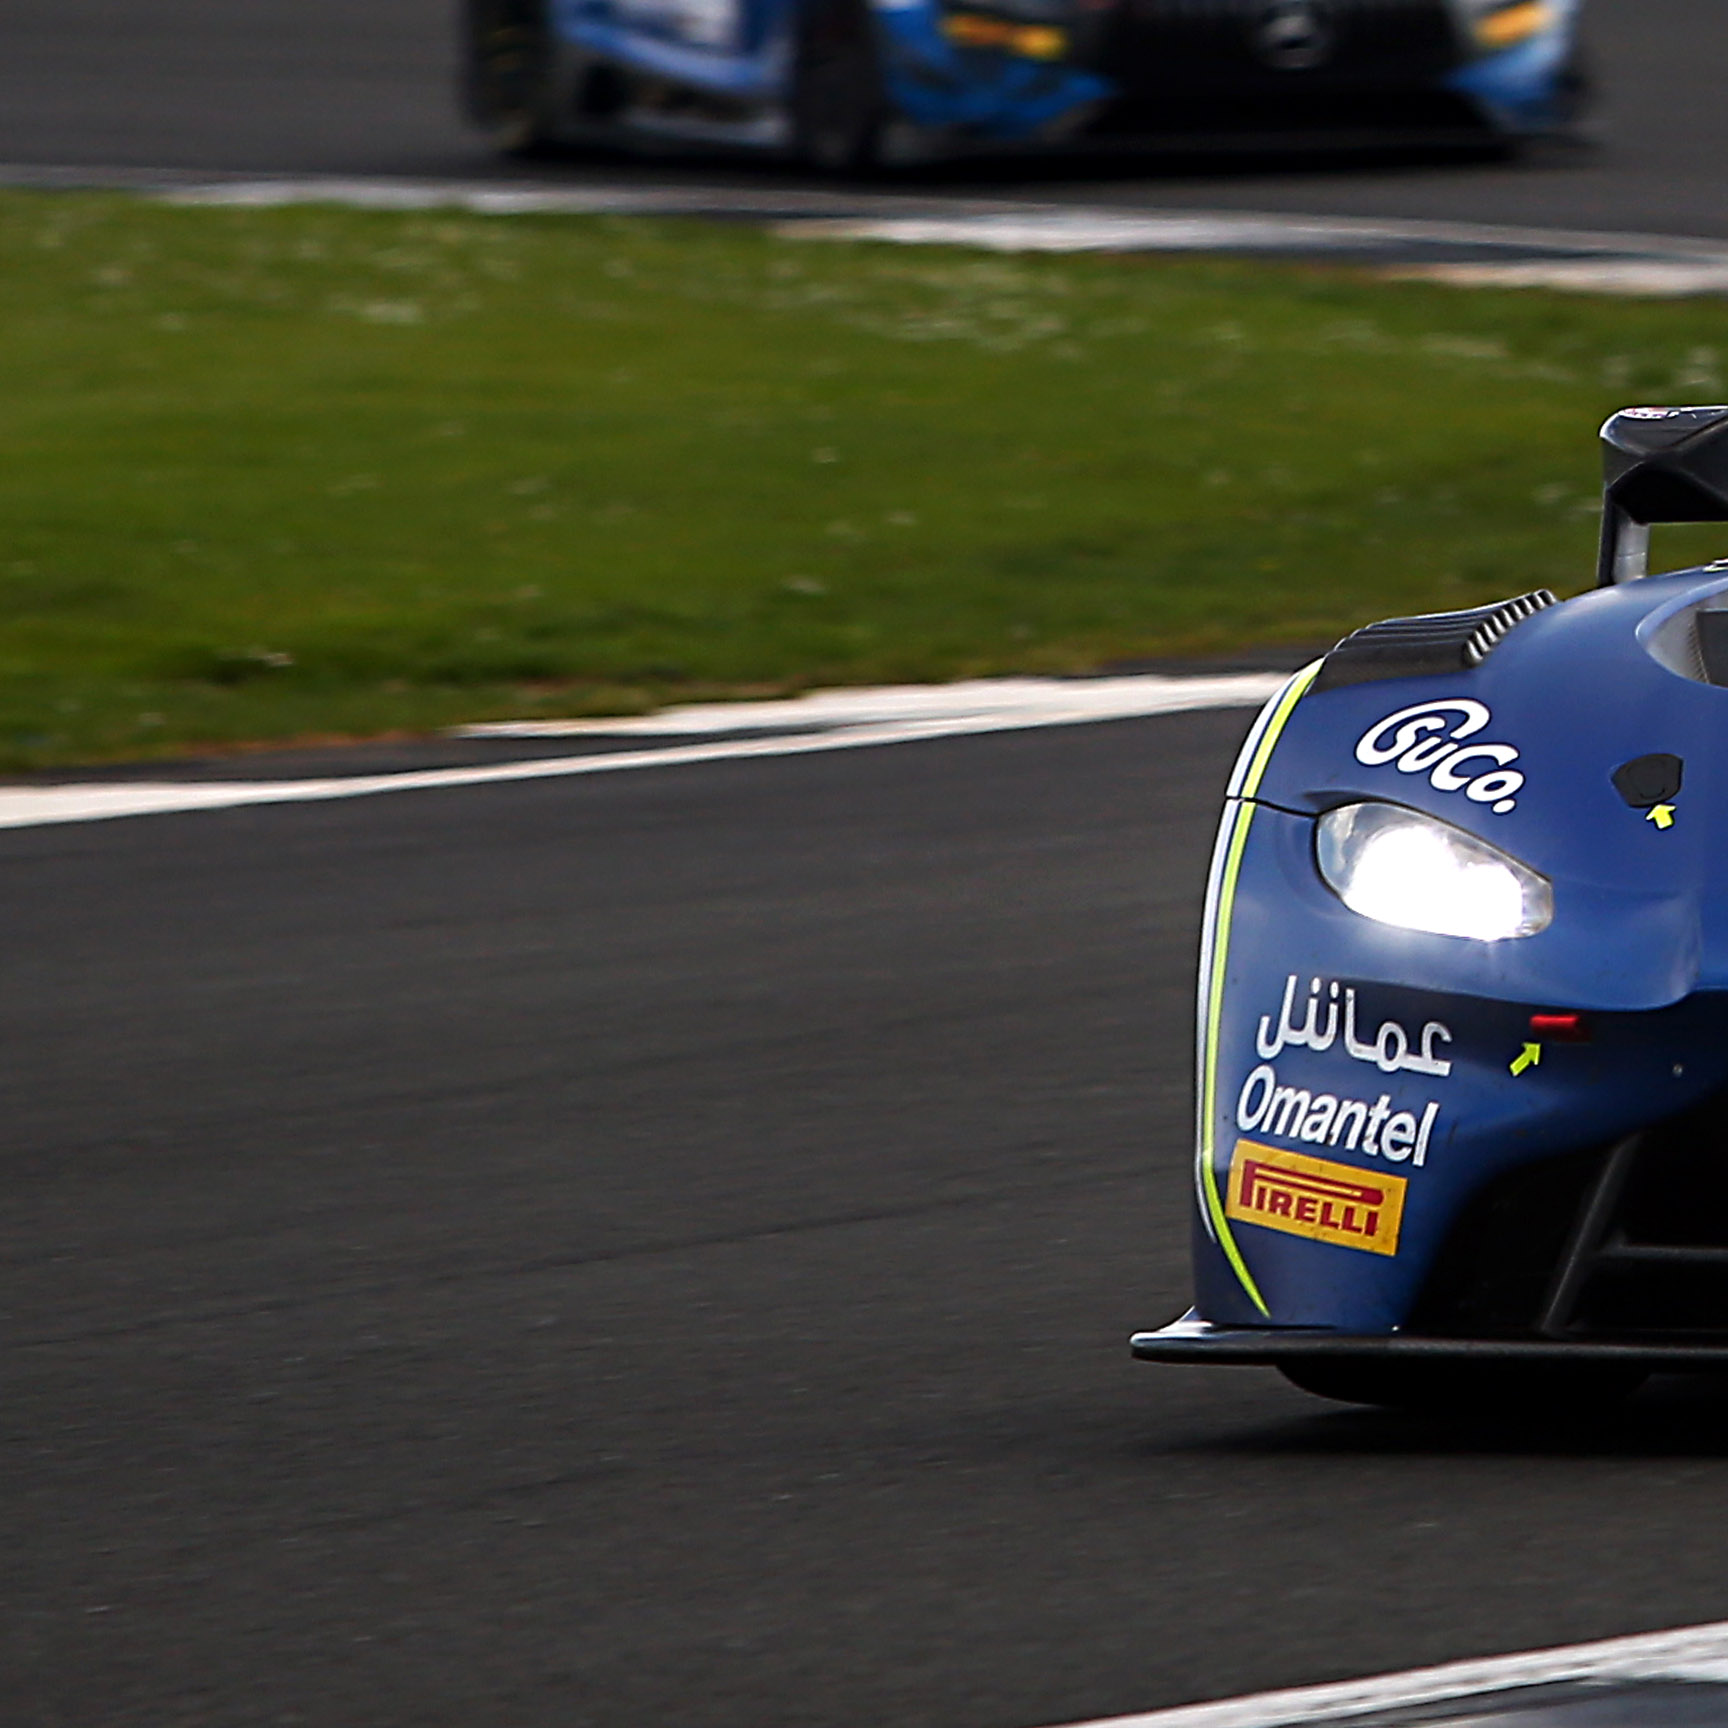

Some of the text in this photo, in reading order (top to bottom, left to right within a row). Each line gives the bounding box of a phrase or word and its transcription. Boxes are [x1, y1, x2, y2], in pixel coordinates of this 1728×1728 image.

[1256, 974, 1452, 1077] عمانتل
[1236, 1065, 1440, 1168] Omantel
[1240, 1159, 1386, 1238] PIRELLI
